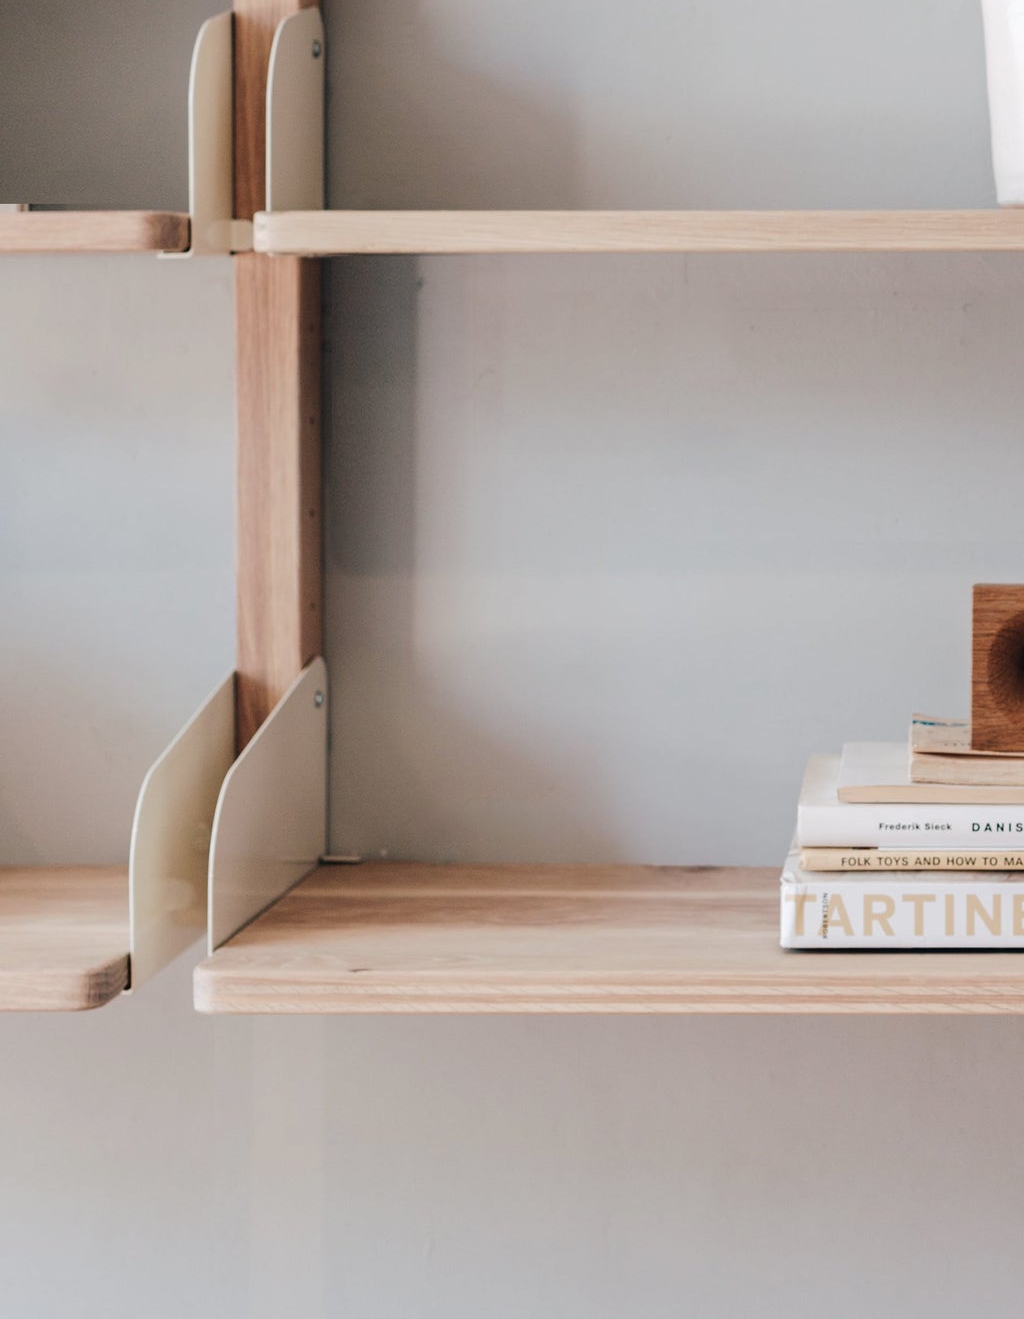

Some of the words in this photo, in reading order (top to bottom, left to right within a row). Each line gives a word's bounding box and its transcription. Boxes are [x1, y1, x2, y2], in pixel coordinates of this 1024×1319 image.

[878, 822, 921, 831] Frederik
[924, 822, 952, 831] Sieck
[841, 857, 871, 867] FOLK
[877, 857, 909, 867] TOYS
[914, 857, 941, 867] AND
[946, 857, 977, 867] HOW
[982, 857, 998, 867] TO
